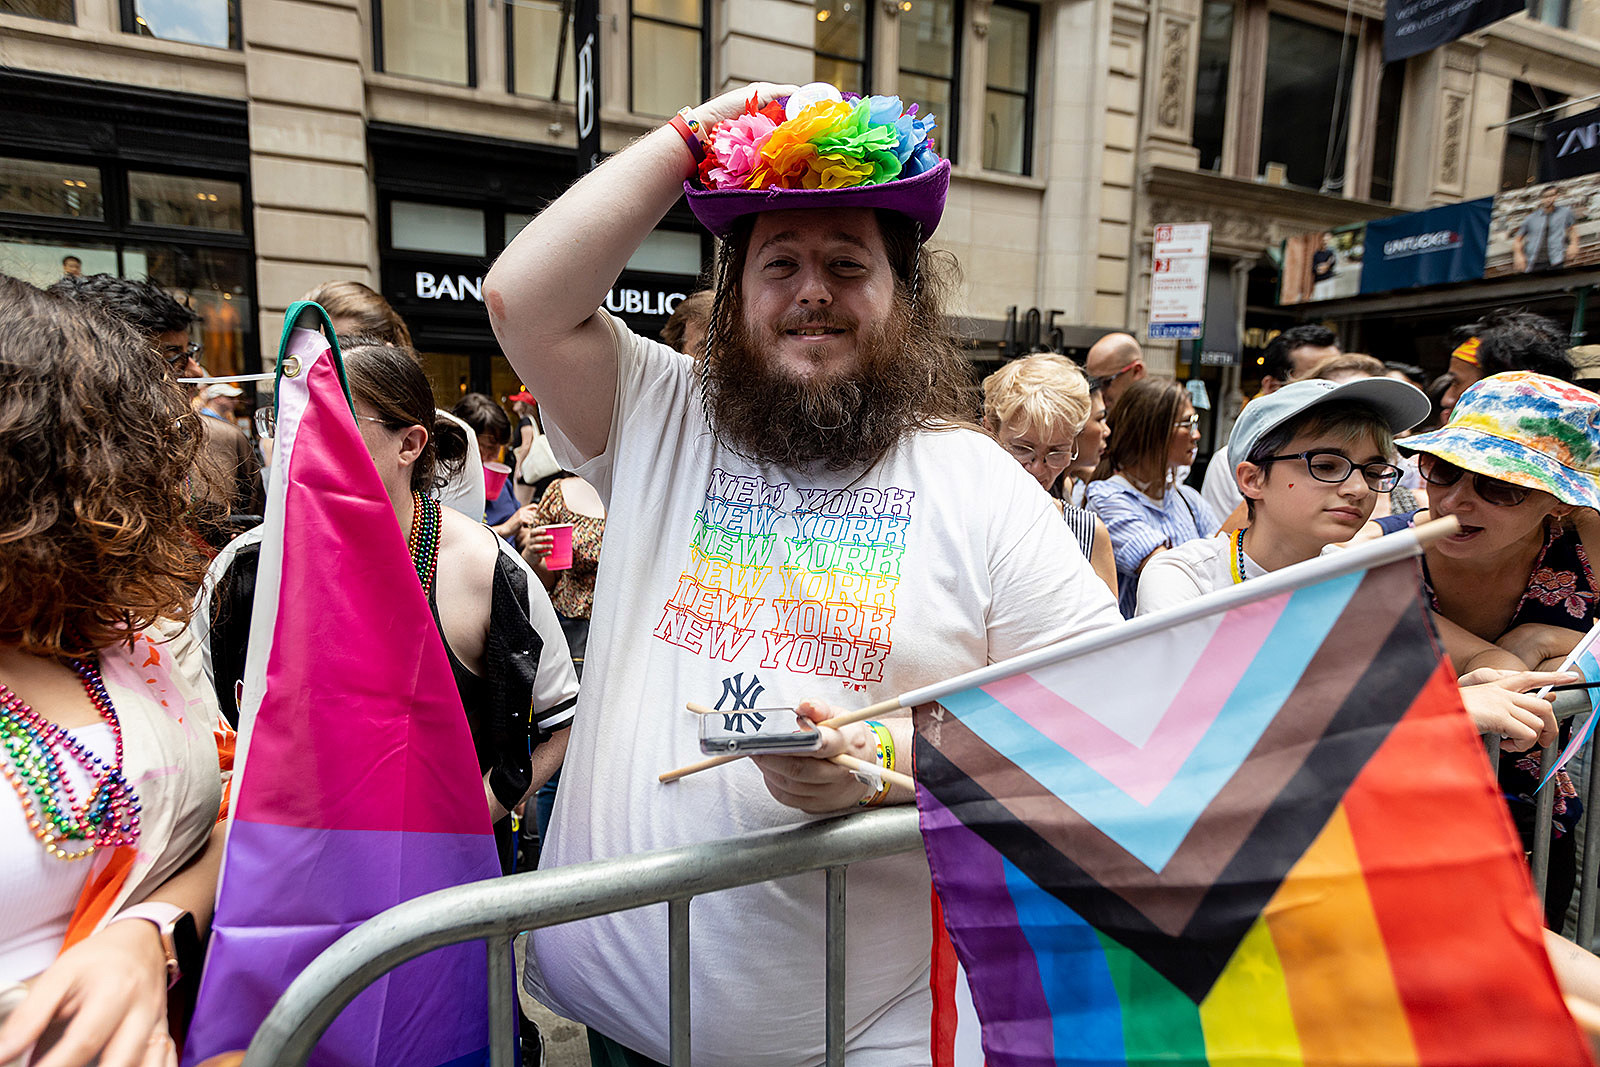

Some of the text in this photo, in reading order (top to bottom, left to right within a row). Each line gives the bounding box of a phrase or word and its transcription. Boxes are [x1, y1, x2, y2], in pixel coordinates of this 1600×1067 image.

[416, 272, 687, 315] BAN UBLIC
[1004, 305, 1064, 355] 105
[706, 468, 916, 521] NEW YORK
[690, 514, 905, 581] NEW YORK
[697, 496, 911, 550] NEW YORK
[779, 565, 900, 614] YORK
[653, 603, 891, 683] NEW YORK
[771, 598, 896, 650] YORK
